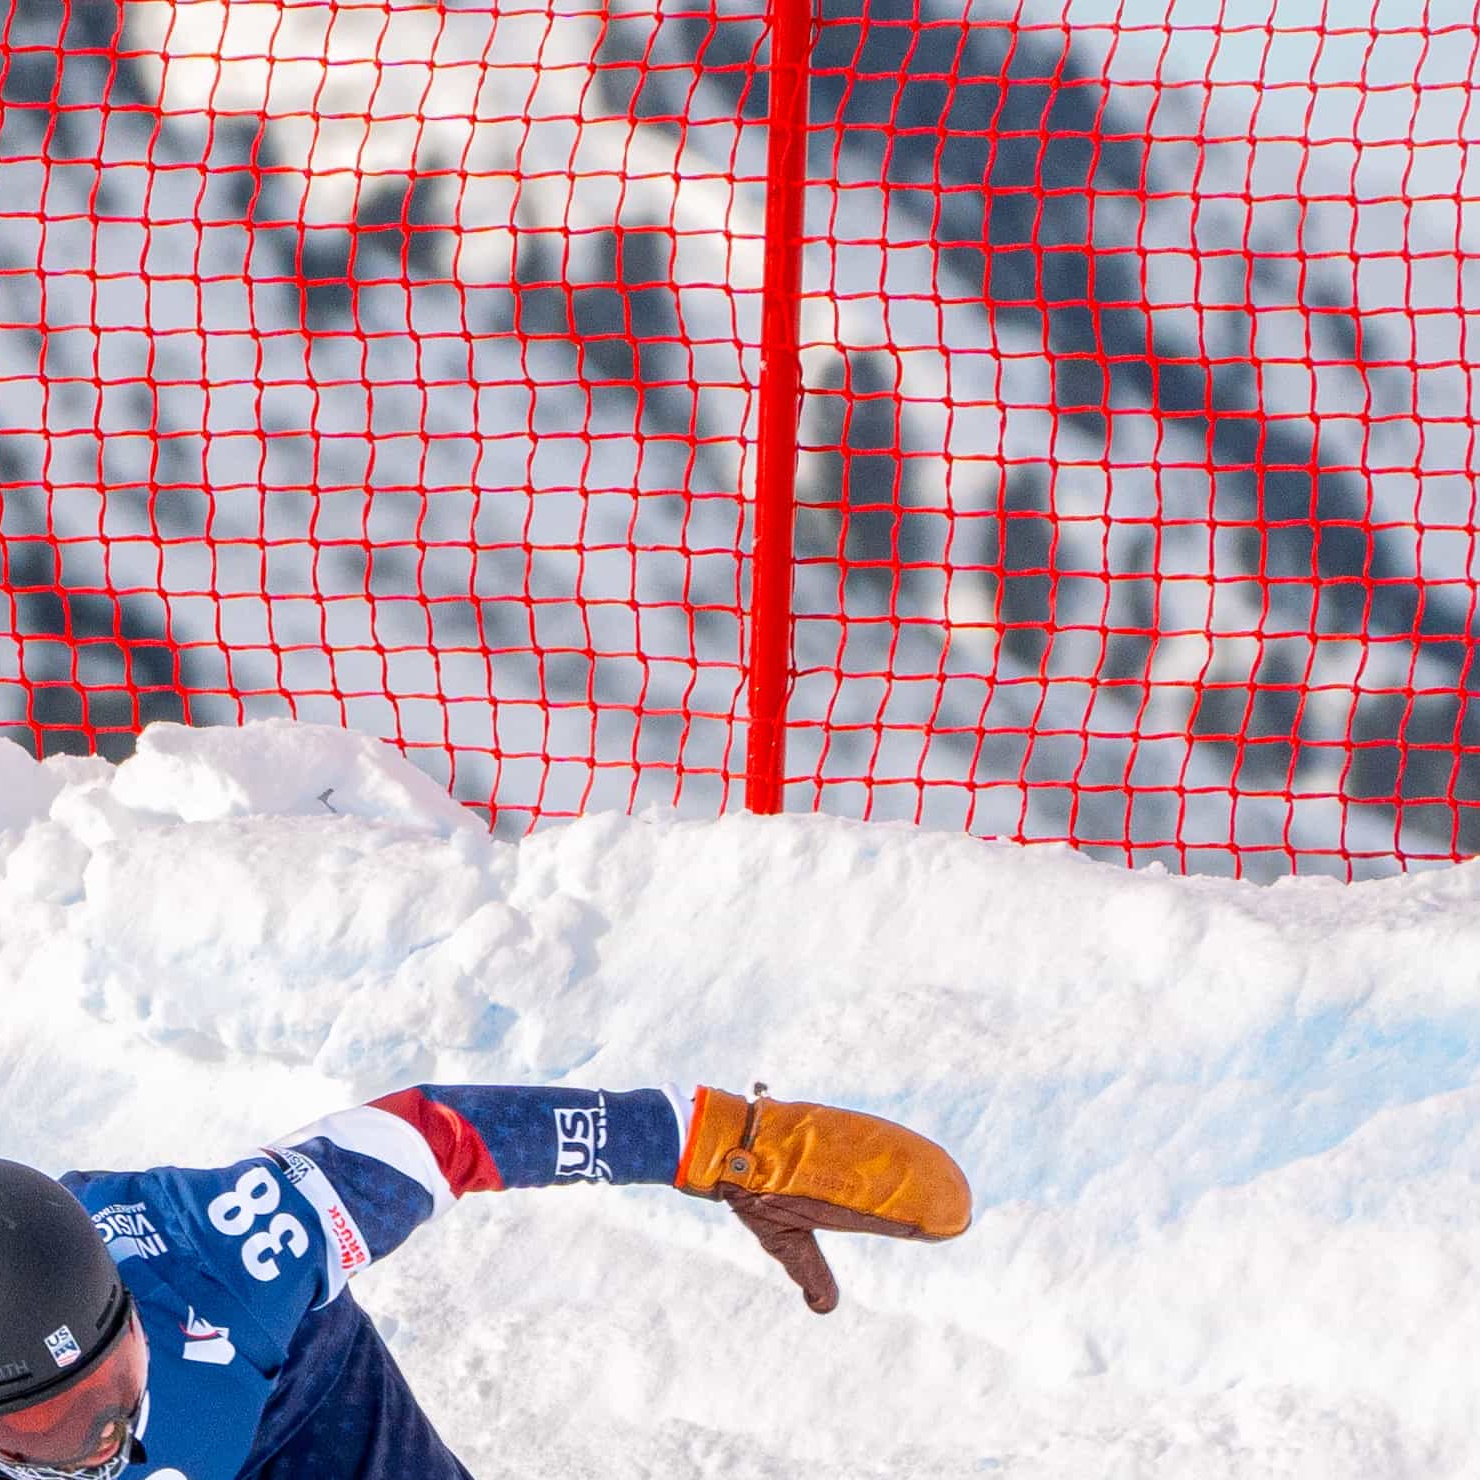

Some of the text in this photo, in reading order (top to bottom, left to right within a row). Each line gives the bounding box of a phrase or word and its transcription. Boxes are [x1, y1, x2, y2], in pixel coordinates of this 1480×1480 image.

[560, 1111, 590, 1173] US
[207, 1166, 310, 1282] 38
[135, 1233, 169, 1260] IN
[47, 1327, 70, 1348] US
